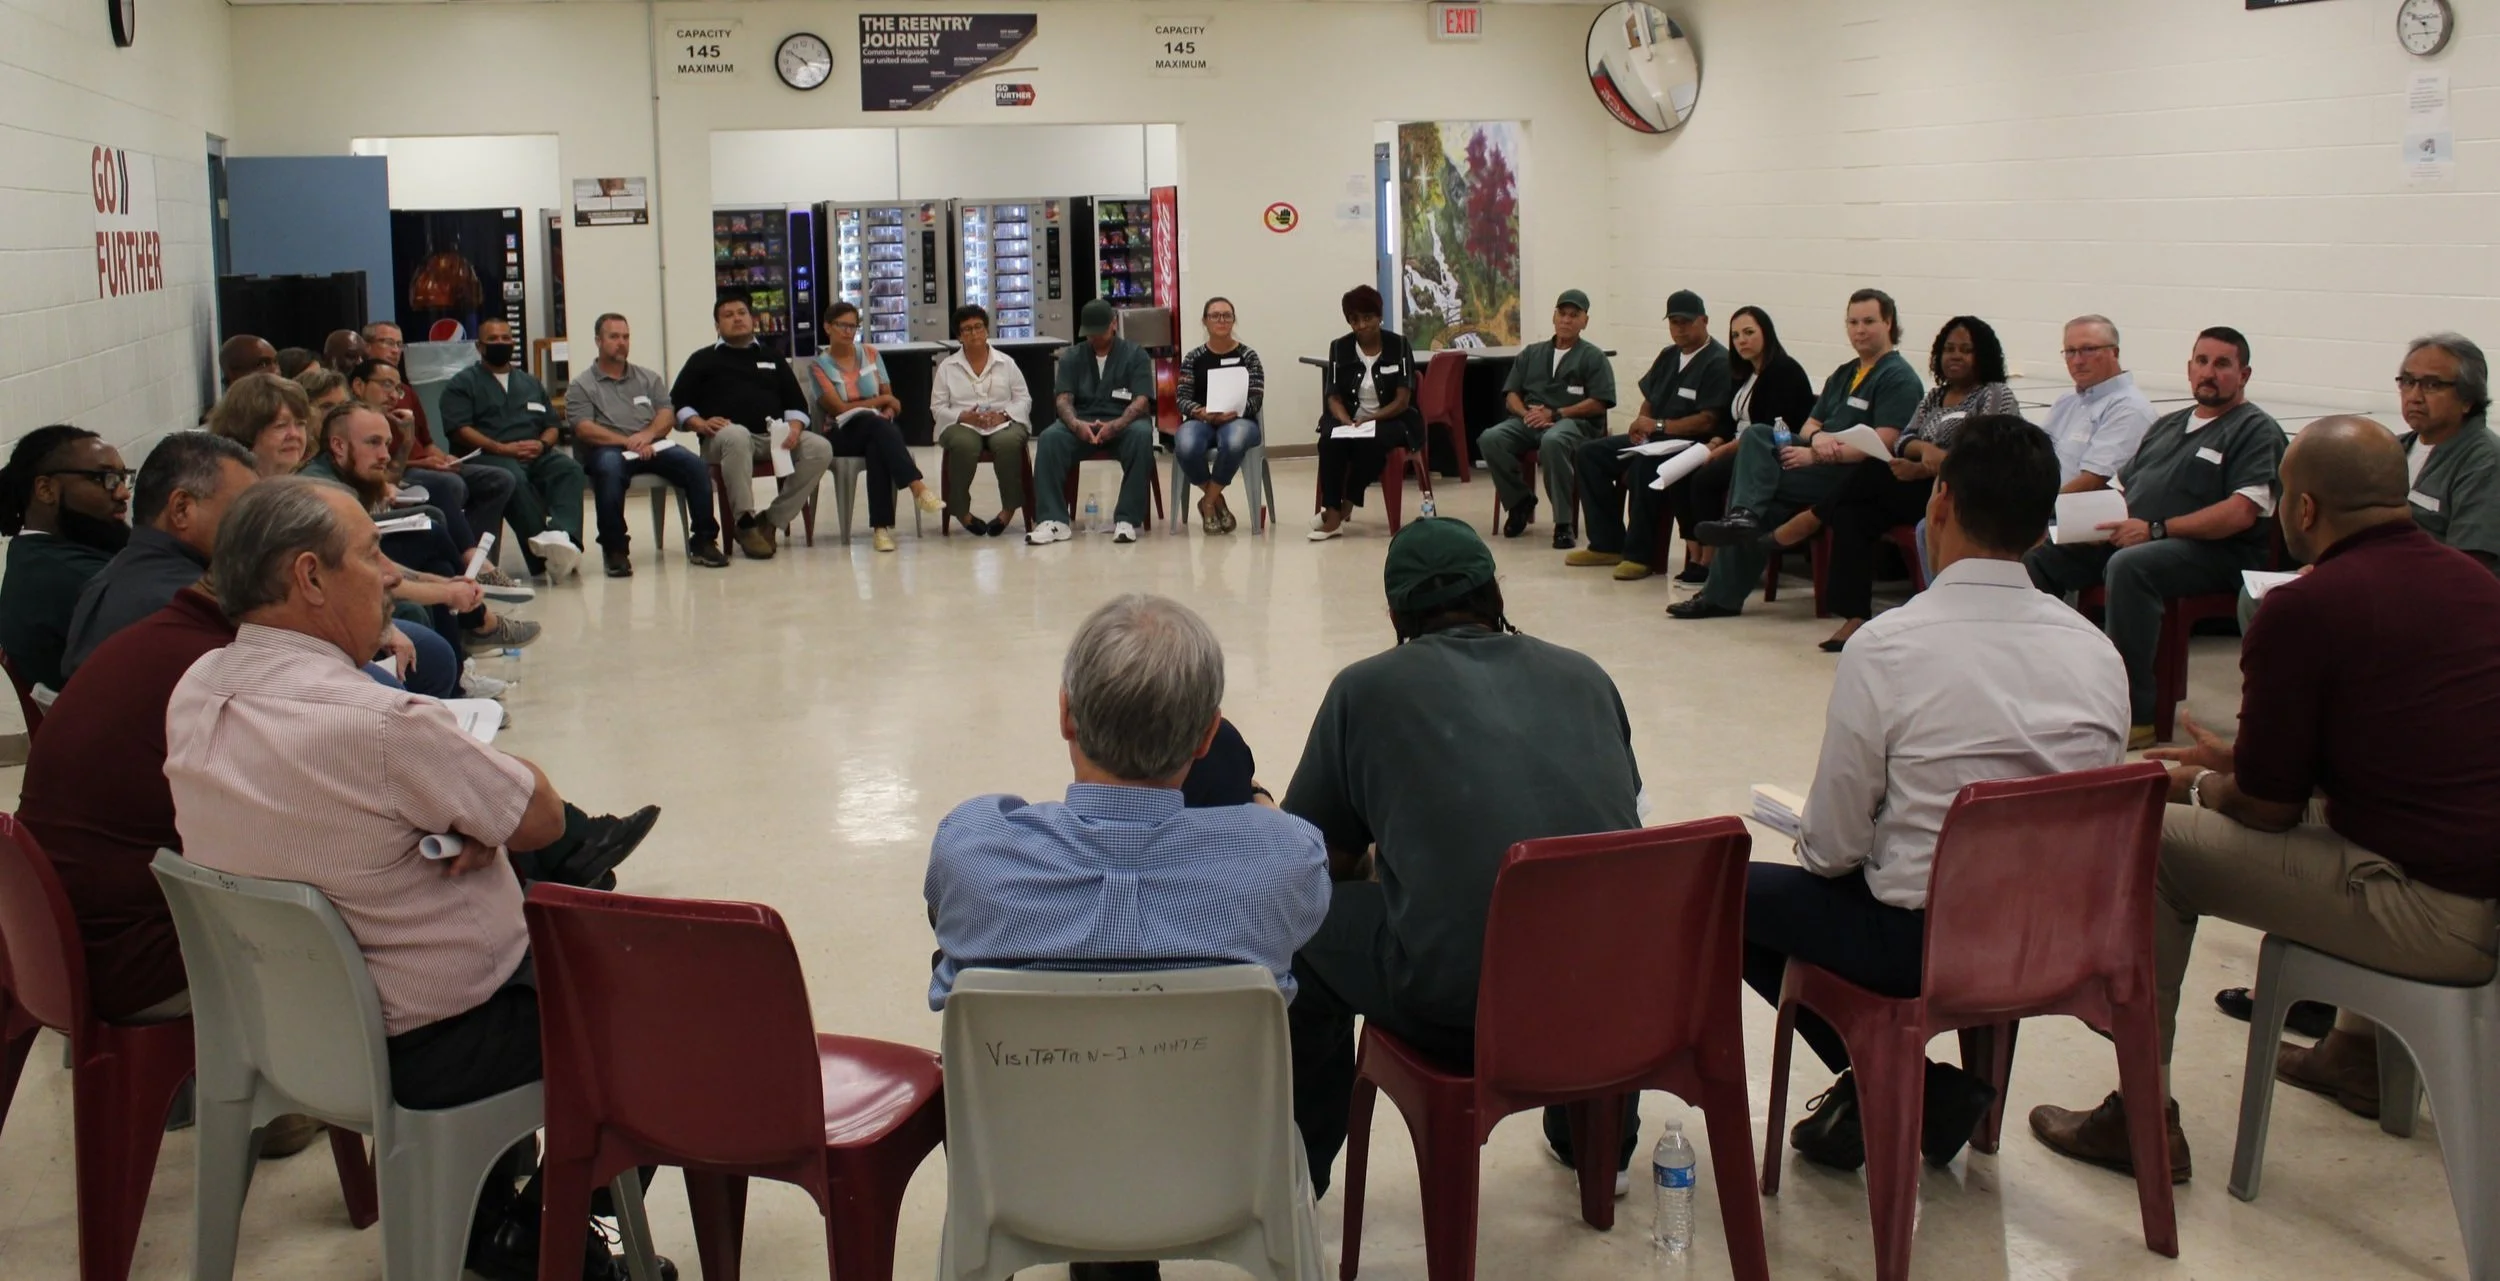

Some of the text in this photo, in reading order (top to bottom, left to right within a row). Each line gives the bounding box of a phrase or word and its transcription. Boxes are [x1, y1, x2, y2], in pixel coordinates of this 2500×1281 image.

[862, 17, 973, 31] THE REENTRY
[1446, 8, 1477, 33] EXIT
[676, 29, 732, 38] CAPACITY
[1155, 26, 1205, 34] CAPACITY
[862, 33, 940, 47] JOURNEY
[686, 45, 721, 58] 145
[862, 48, 895, 56] Common
[896, 48, 929, 58] language
[1164, 41, 1196, 54] 145
[677, 64, 734, 73] MAXIMUM
[1155, 60, 1206, 68] MAXIMUM
[92, 145, 116, 214] GO
[96, 231, 163, 299] FURTHER
